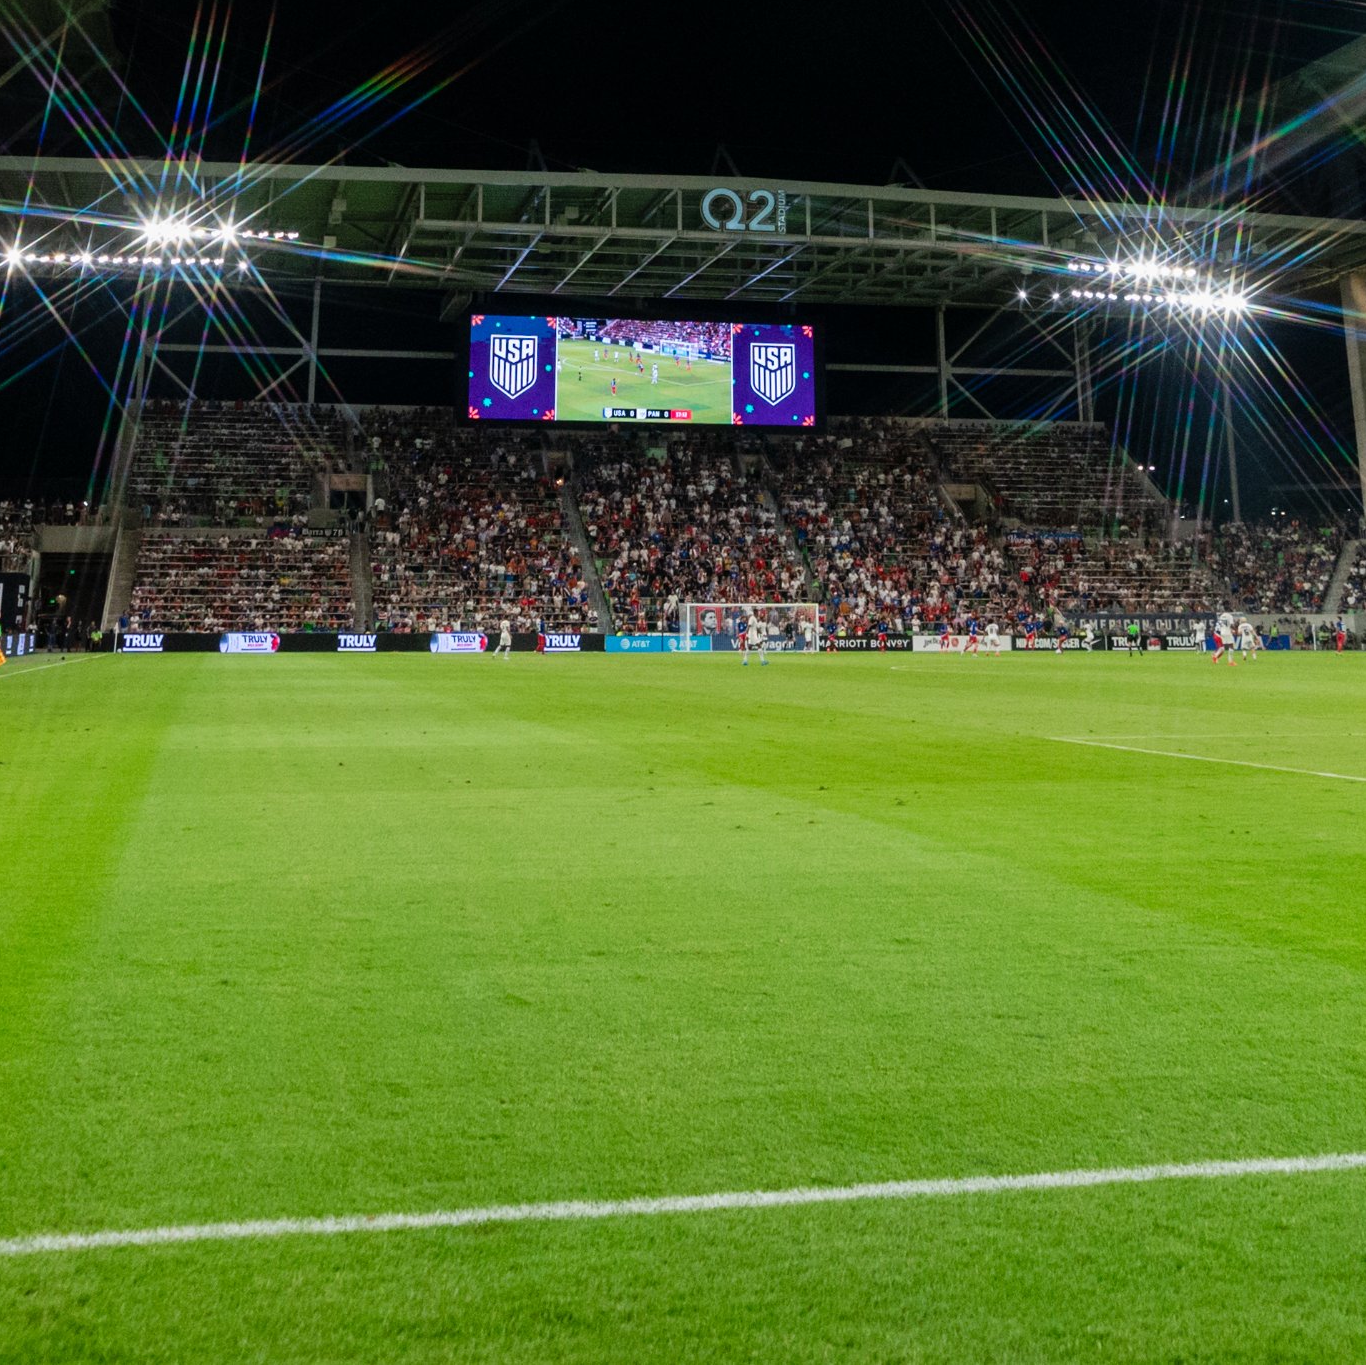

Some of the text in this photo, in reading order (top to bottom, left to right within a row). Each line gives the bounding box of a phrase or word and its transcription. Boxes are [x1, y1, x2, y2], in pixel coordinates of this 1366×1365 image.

[702, 187, 775, 231] Q2
[778, 190, 786, 234] STADIUM
[494, 339, 534, 363] USA
[754, 346, 791, 370] USA
[1080, 619, 1149, 631] AMERCAN
[124, 635, 164, 647] TRULY
[242, 635, 268, 643] TRULY
[337, 635, 376, 647] TRULY
[451, 635, 476, 643] TRULY
[545, 635, 581, 647] TRULY
[632, 640, 650, 648] AT&T
[1112, 636, 1141, 646] TRU
[1166, 636, 1195, 646] TRULY
